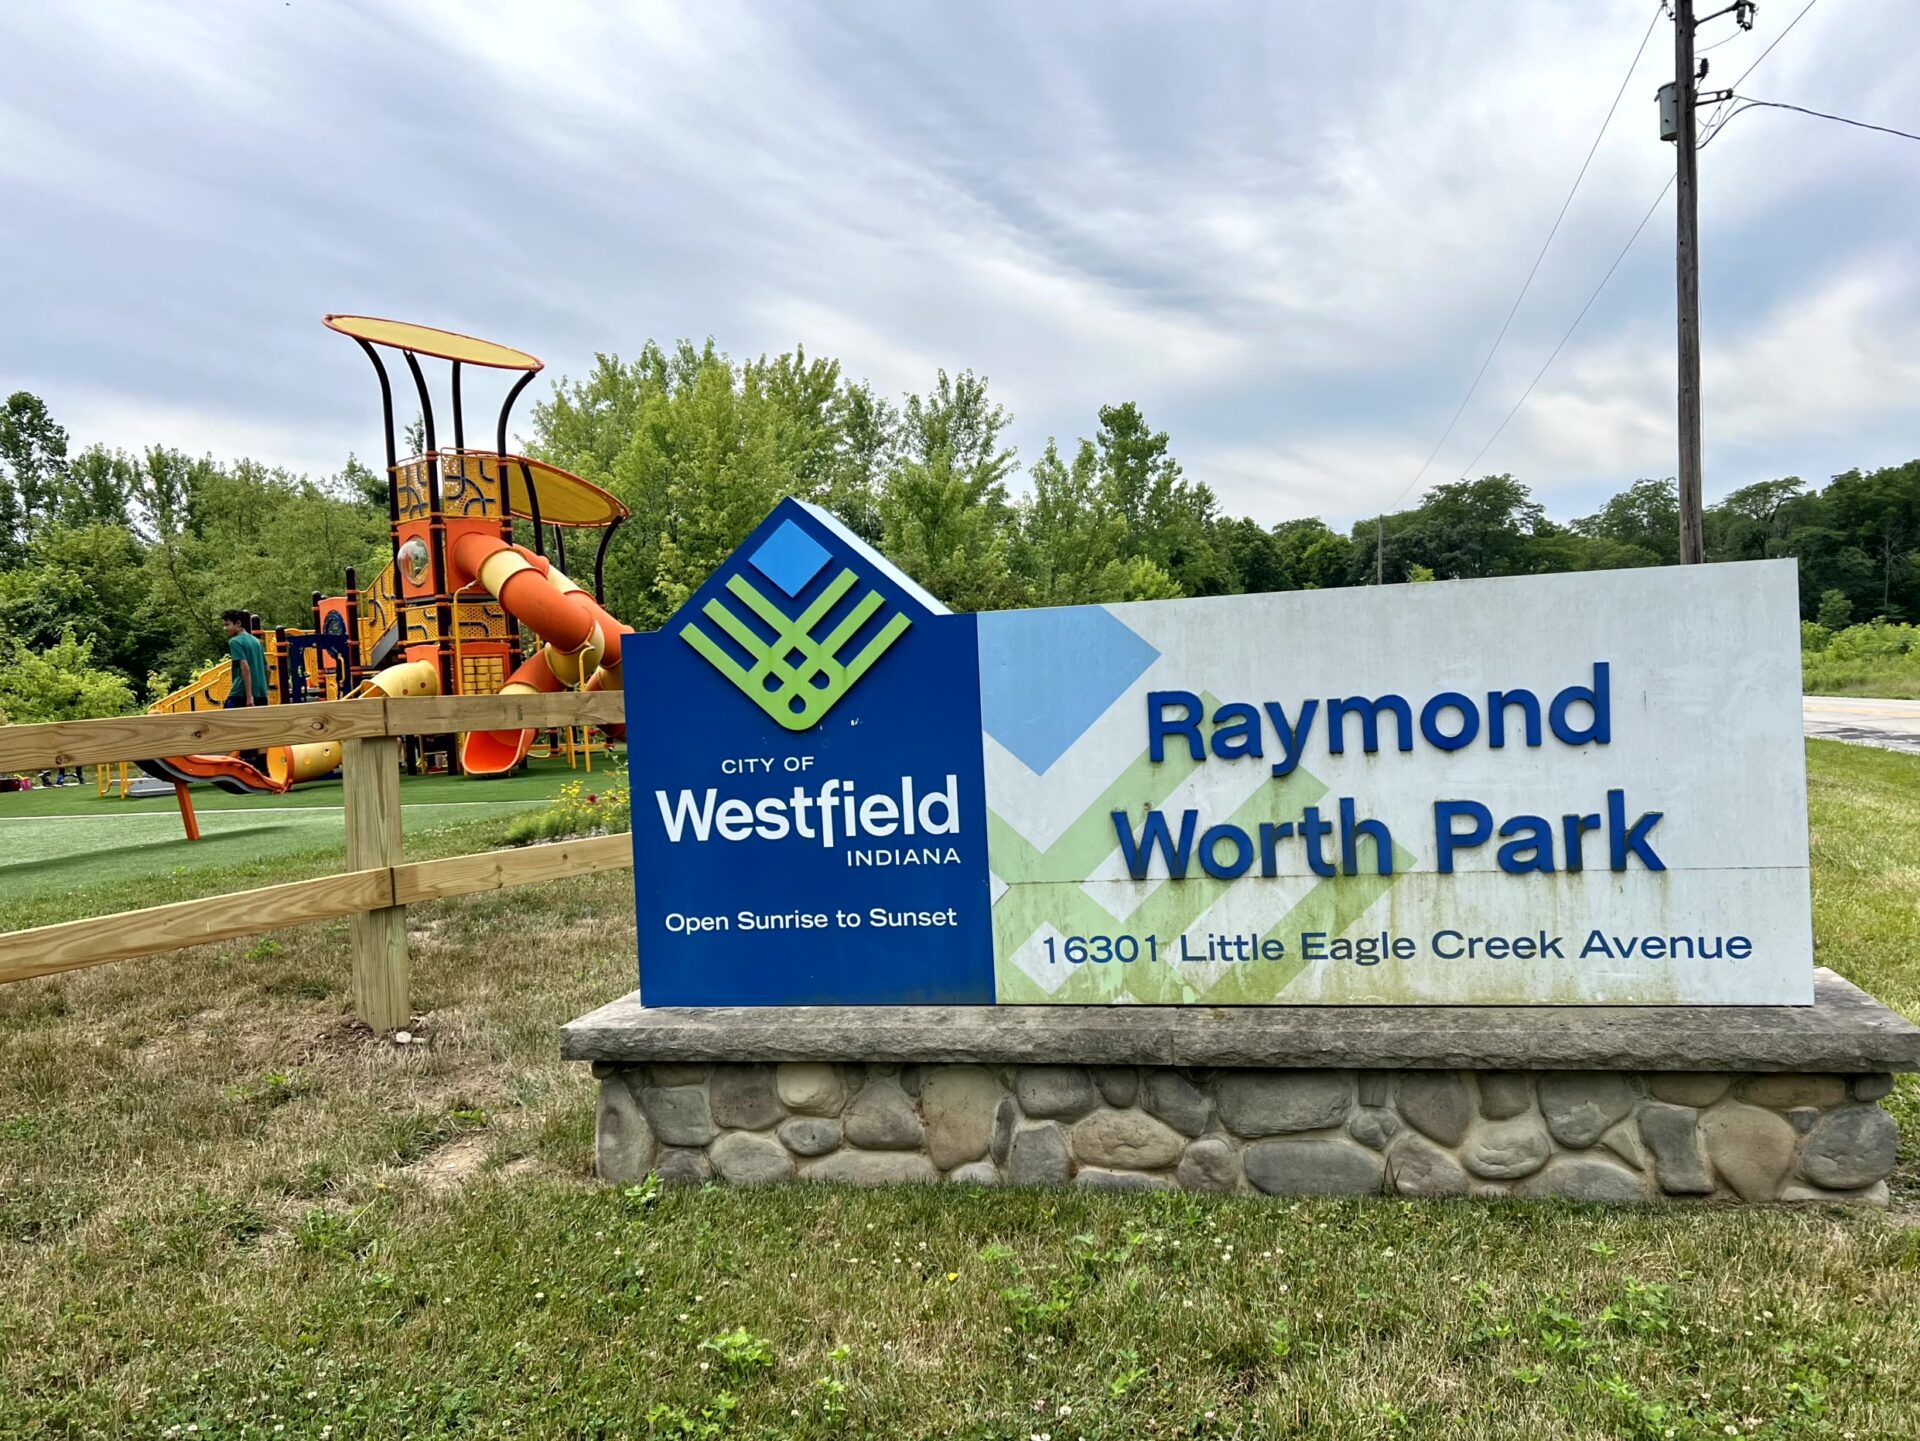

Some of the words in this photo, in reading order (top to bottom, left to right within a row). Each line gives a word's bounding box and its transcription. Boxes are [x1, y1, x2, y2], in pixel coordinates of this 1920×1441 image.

[1147, 662, 1610, 777] Raymond
[721, 757, 775, 774] CITY
[784, 756, 815, 772] OF
[655, 774, 960, 848] Westfield
[1111, 797, 1393, 881] Worth
[1434, 789, 1667, 875] Park
[847, 848, 961, 867] INDIANA
[665, 911, 729, 935] Open
[737, 910, 828, 930] Sunrise
[836, 910, 861, 928] to
[869, 907, 958, 927] Sunset
[1043, 935, 1157, 964] 16301
[1180, 932, 1285, 962] Little
[1300, 932, 1417, 966] Eagle
[1431, 930, 1565, 960] Creek
[1578, 929, 1753, 960] Avenue
